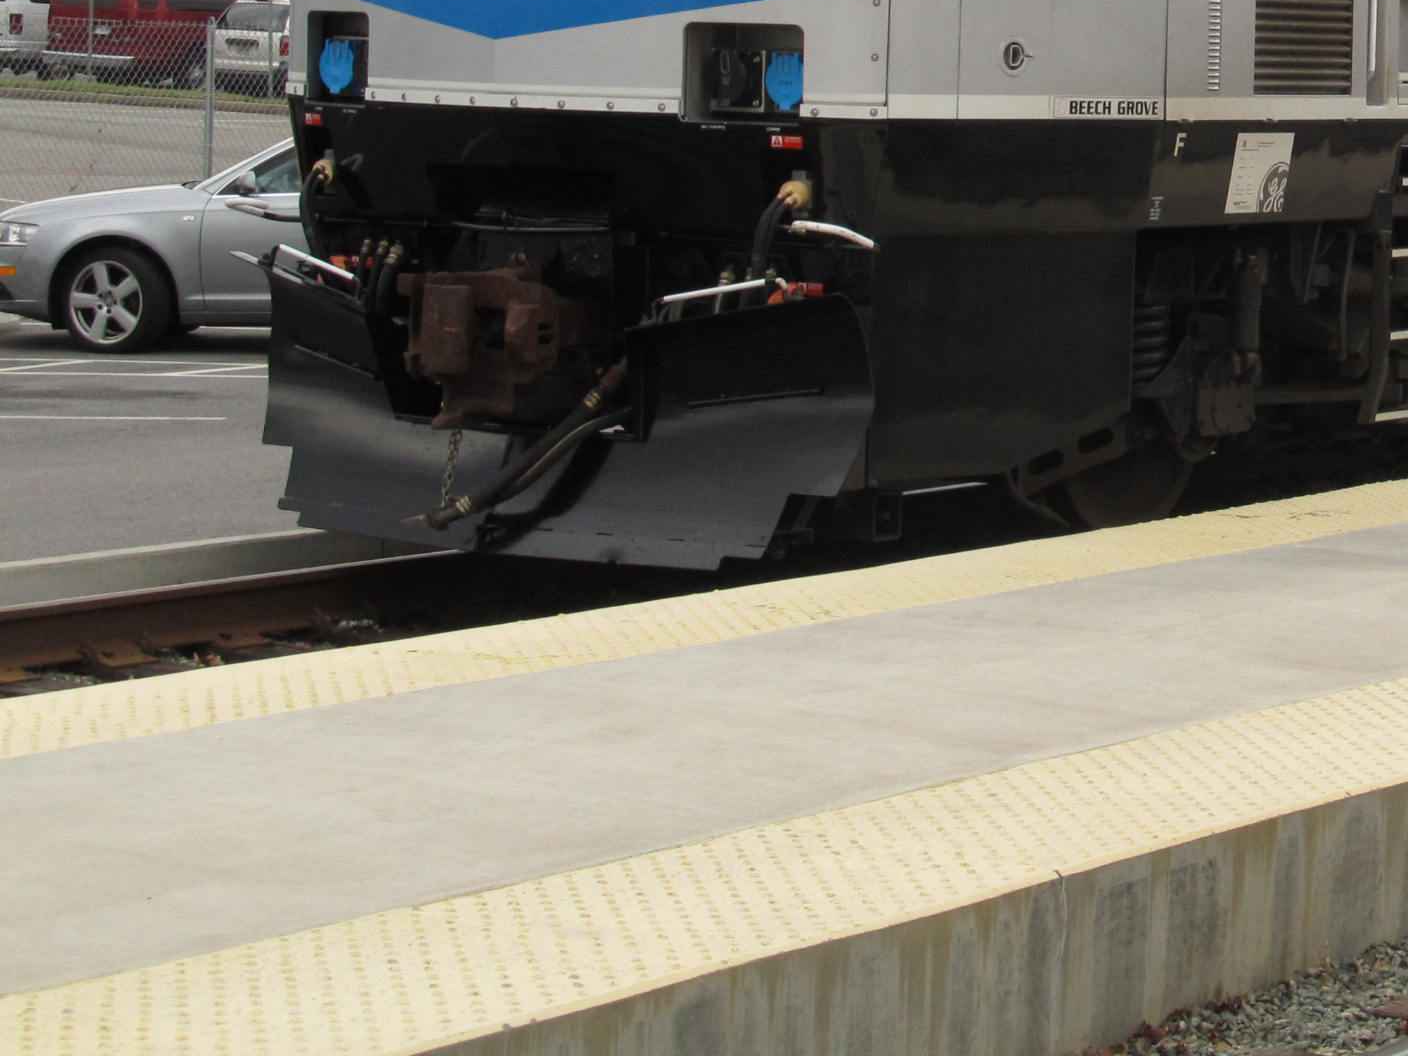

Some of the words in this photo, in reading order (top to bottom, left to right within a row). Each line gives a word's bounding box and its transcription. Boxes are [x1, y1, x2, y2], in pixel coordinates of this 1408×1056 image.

[1069, 100, 1112, 115] BEECH
[1117, 100, 1159, 116] GROVE
[1173, 132, 1187, 157] F
